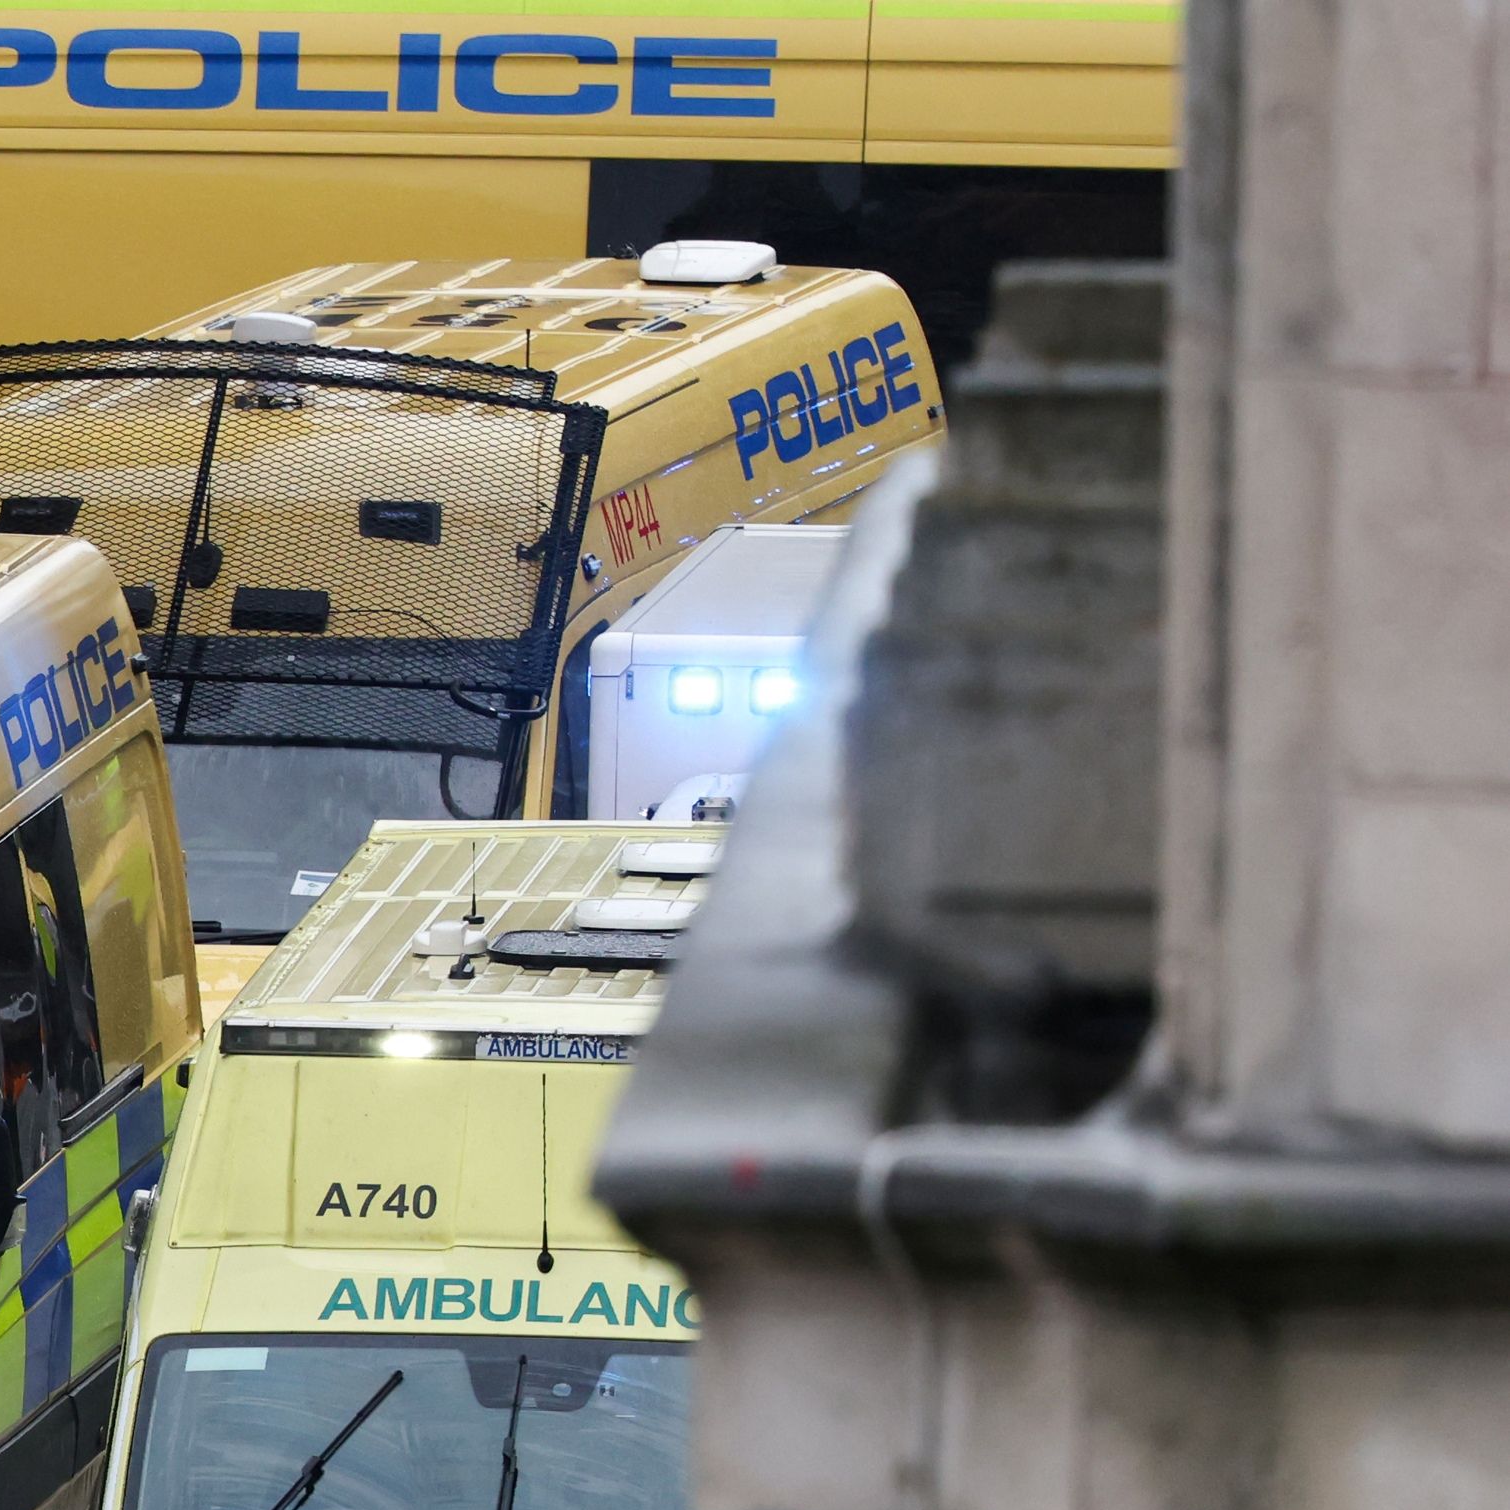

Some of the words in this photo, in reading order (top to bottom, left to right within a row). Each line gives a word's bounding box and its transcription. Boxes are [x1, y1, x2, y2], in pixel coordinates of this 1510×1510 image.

[727, 321, 922, 482] POLICE
[600, 482, 662, 569] MP44
[487, 1037, 629, 1060] AMBULANCE
[315, 1181, 438, 1220] A740
[317, 1277, 704, 1330] AMBULANC
